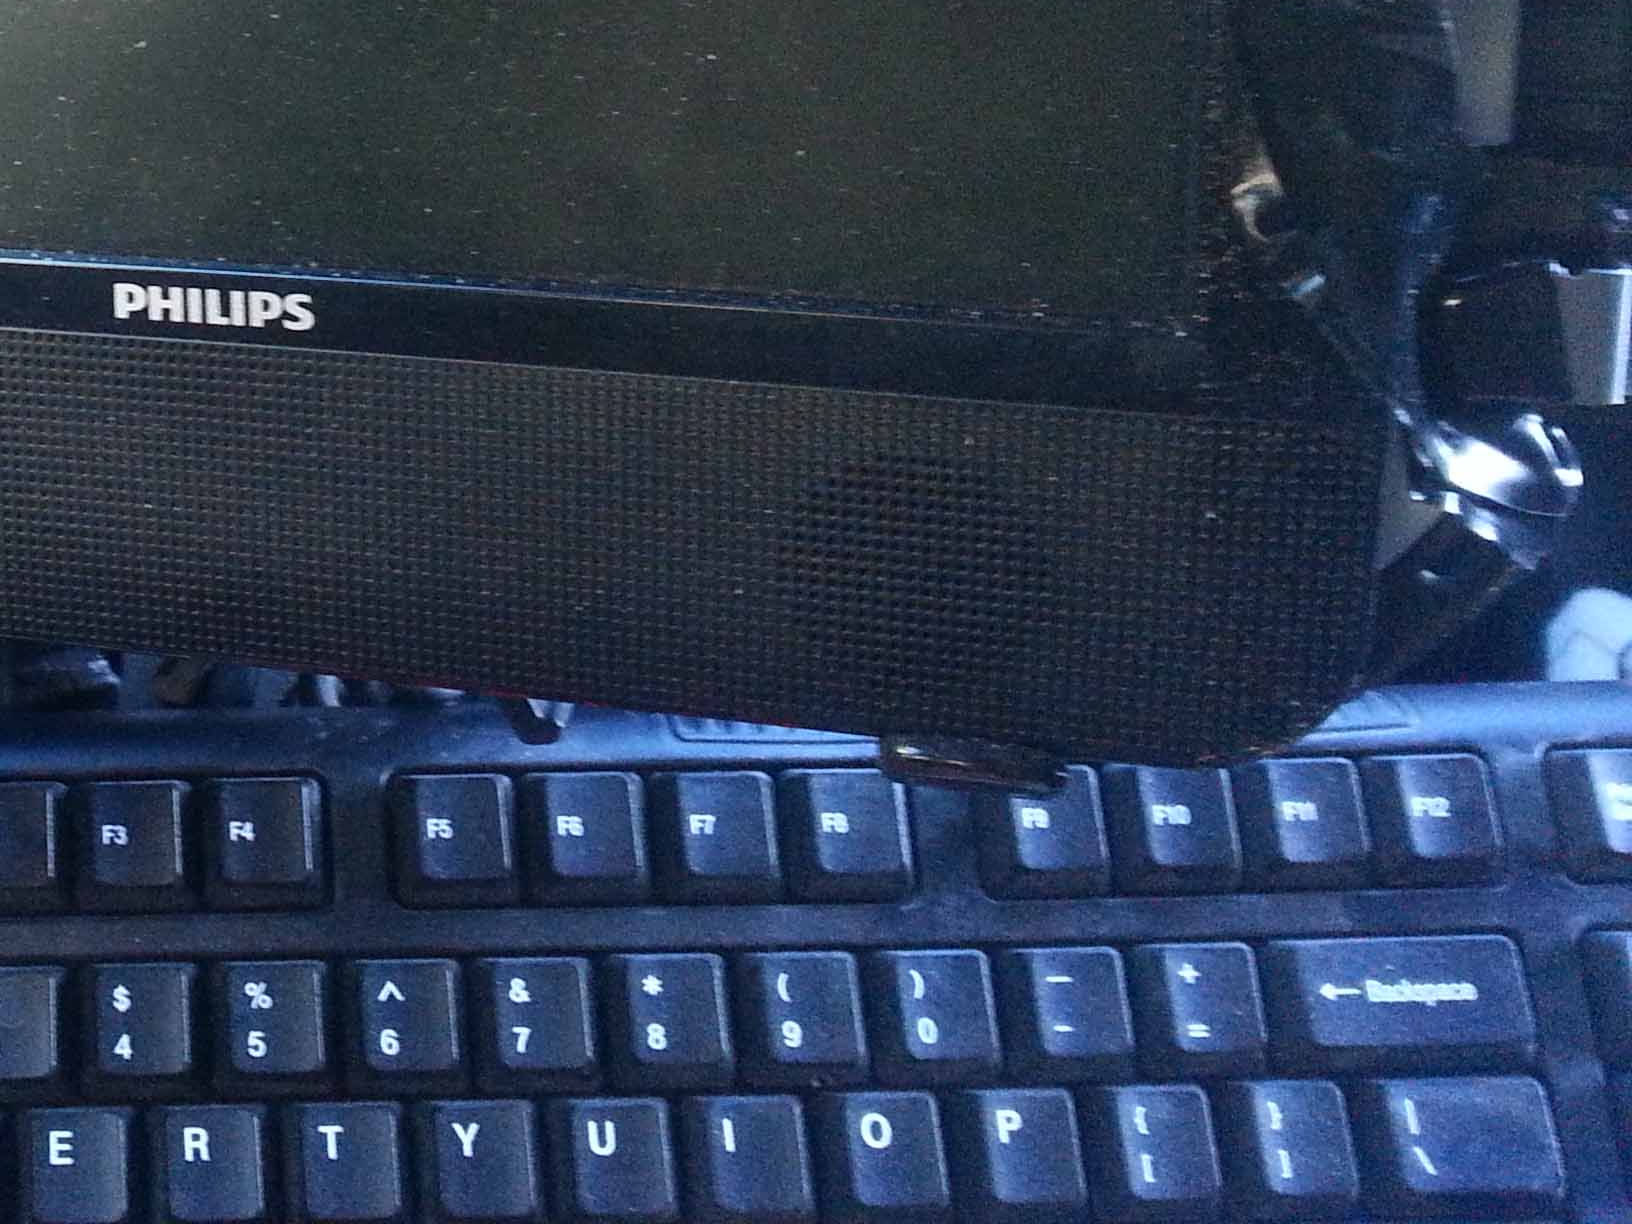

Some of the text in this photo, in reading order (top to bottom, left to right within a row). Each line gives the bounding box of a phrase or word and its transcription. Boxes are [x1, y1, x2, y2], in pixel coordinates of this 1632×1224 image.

[112, 282, 315, 332] PHILIPS
[1410, 795, 1452, 818] F12
[101, 824, 128, 845] F3
[228, 820, 255, 842] F4
[425, 817, 454, 839] F5
[556, 815, 585, 837] F6
[688, 813, 717, 835] F7
[1177, 961, 1202, 985] +
[112, 984, 132, 1013] $
[244, 981, 273, 1009] %
[508, 977, 531, 1004] &
[113, 1033, 133, 1060] 4
[247, 1030, 267, 1058] 5
[379, 1028, 400, 1056] 6
[511, 1026, 532, 1054] 7
[646, 1022, 668, 1050] 8
[780, 1020, 803, 1048] 9
[451, 1122, 480, 1158] Y
[587, 1120, 617, 1157] U
[721, 1117, 736, 1153] I
[859, 1111, 893, 1149] O
[993, 1108, 1023, 1145] P
[49, 1130, 75, 1166] E
[183, 1126, 211, 1162] R
[317, 1124, 344, 1160] T
